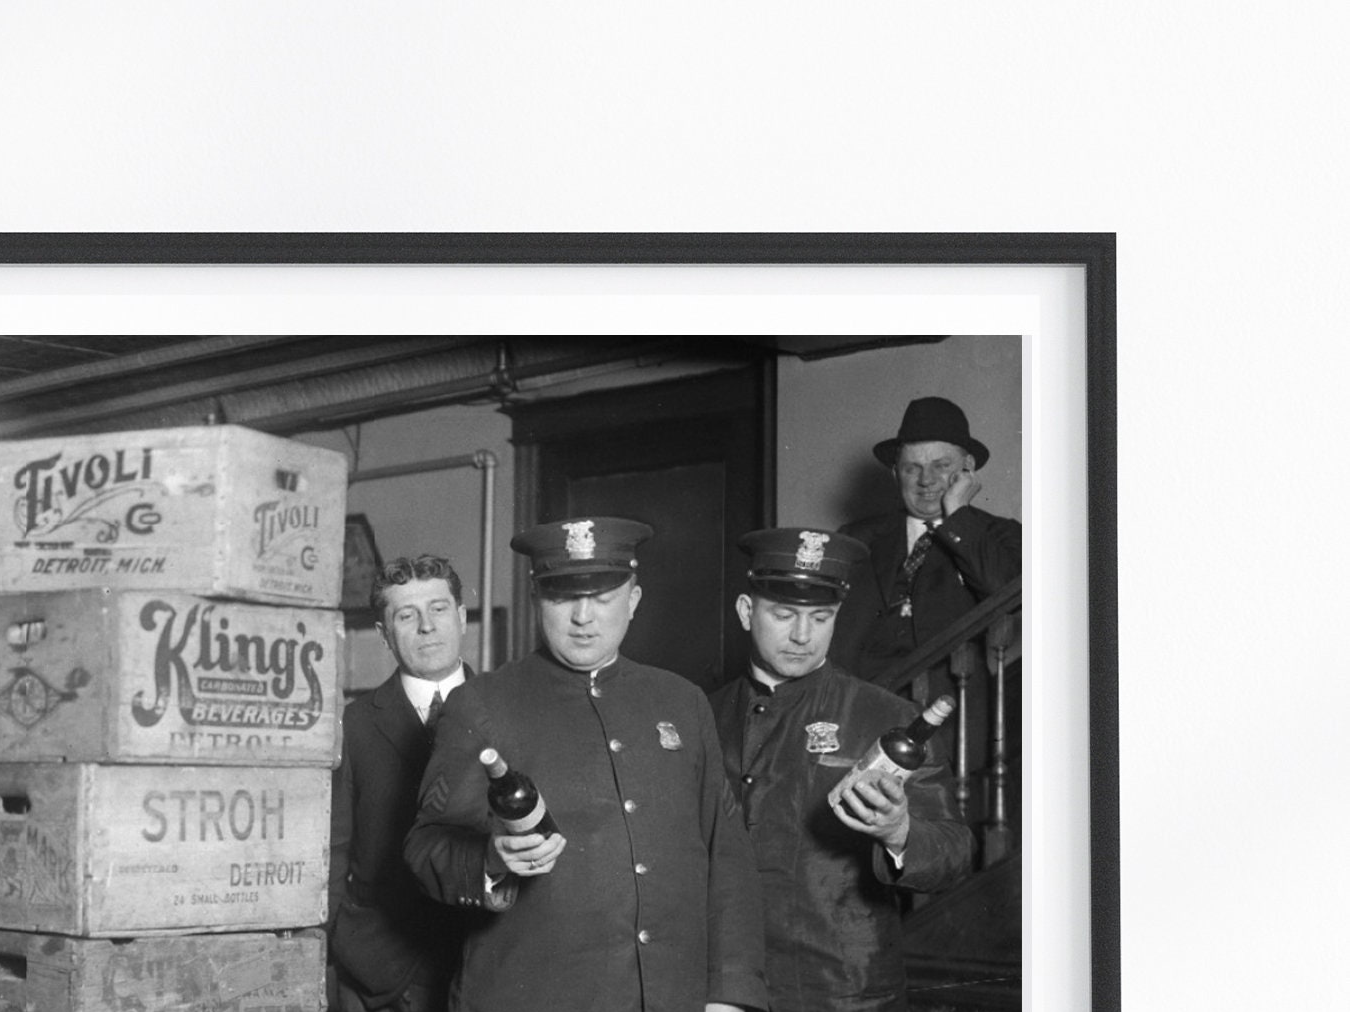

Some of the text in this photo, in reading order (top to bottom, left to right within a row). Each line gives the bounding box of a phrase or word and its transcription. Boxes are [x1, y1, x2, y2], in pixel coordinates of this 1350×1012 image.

[131, 600, 324, 730] Kling's
[201, 680, 266, 694] CARBONATED
[192, 702, 311, 727] BEVERAGES
[140, 788, 285, 843] STROH
[229, 861, 305, 887] DETROIT
[190, 893, 219, 906] SMALL
[224, 891, 260, 904] BOTTLES
